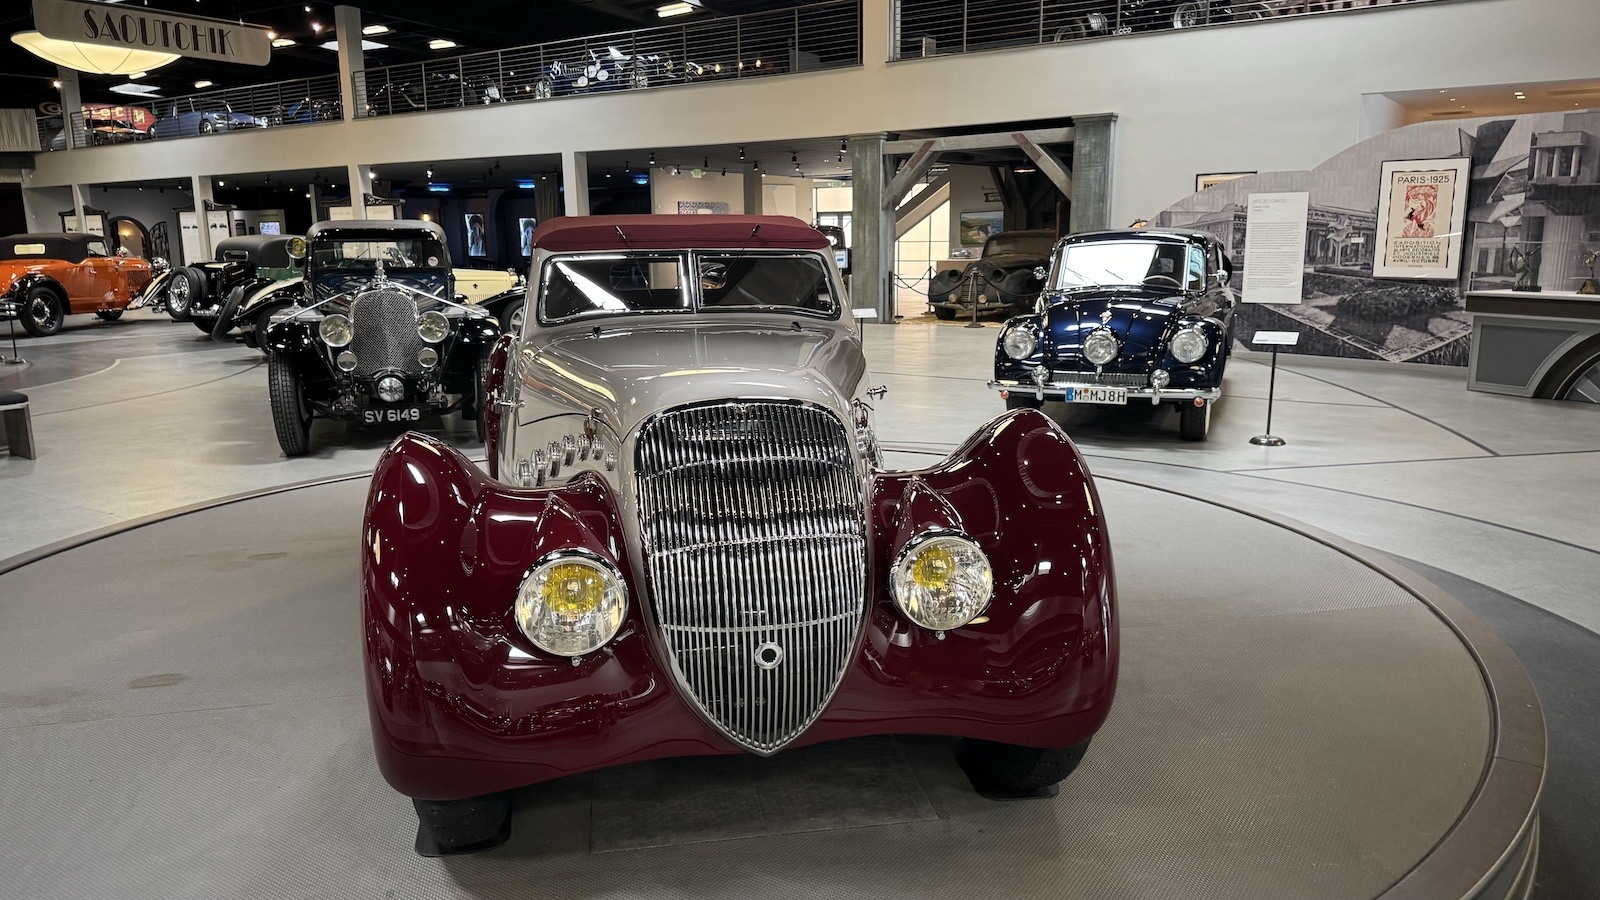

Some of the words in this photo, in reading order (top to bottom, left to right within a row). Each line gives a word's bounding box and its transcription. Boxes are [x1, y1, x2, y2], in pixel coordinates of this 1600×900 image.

[83, 9, 234, 56] SAOUTCHIK
[364, 410, 383, 423] SV
[387, 408, 420, 422] 6149
